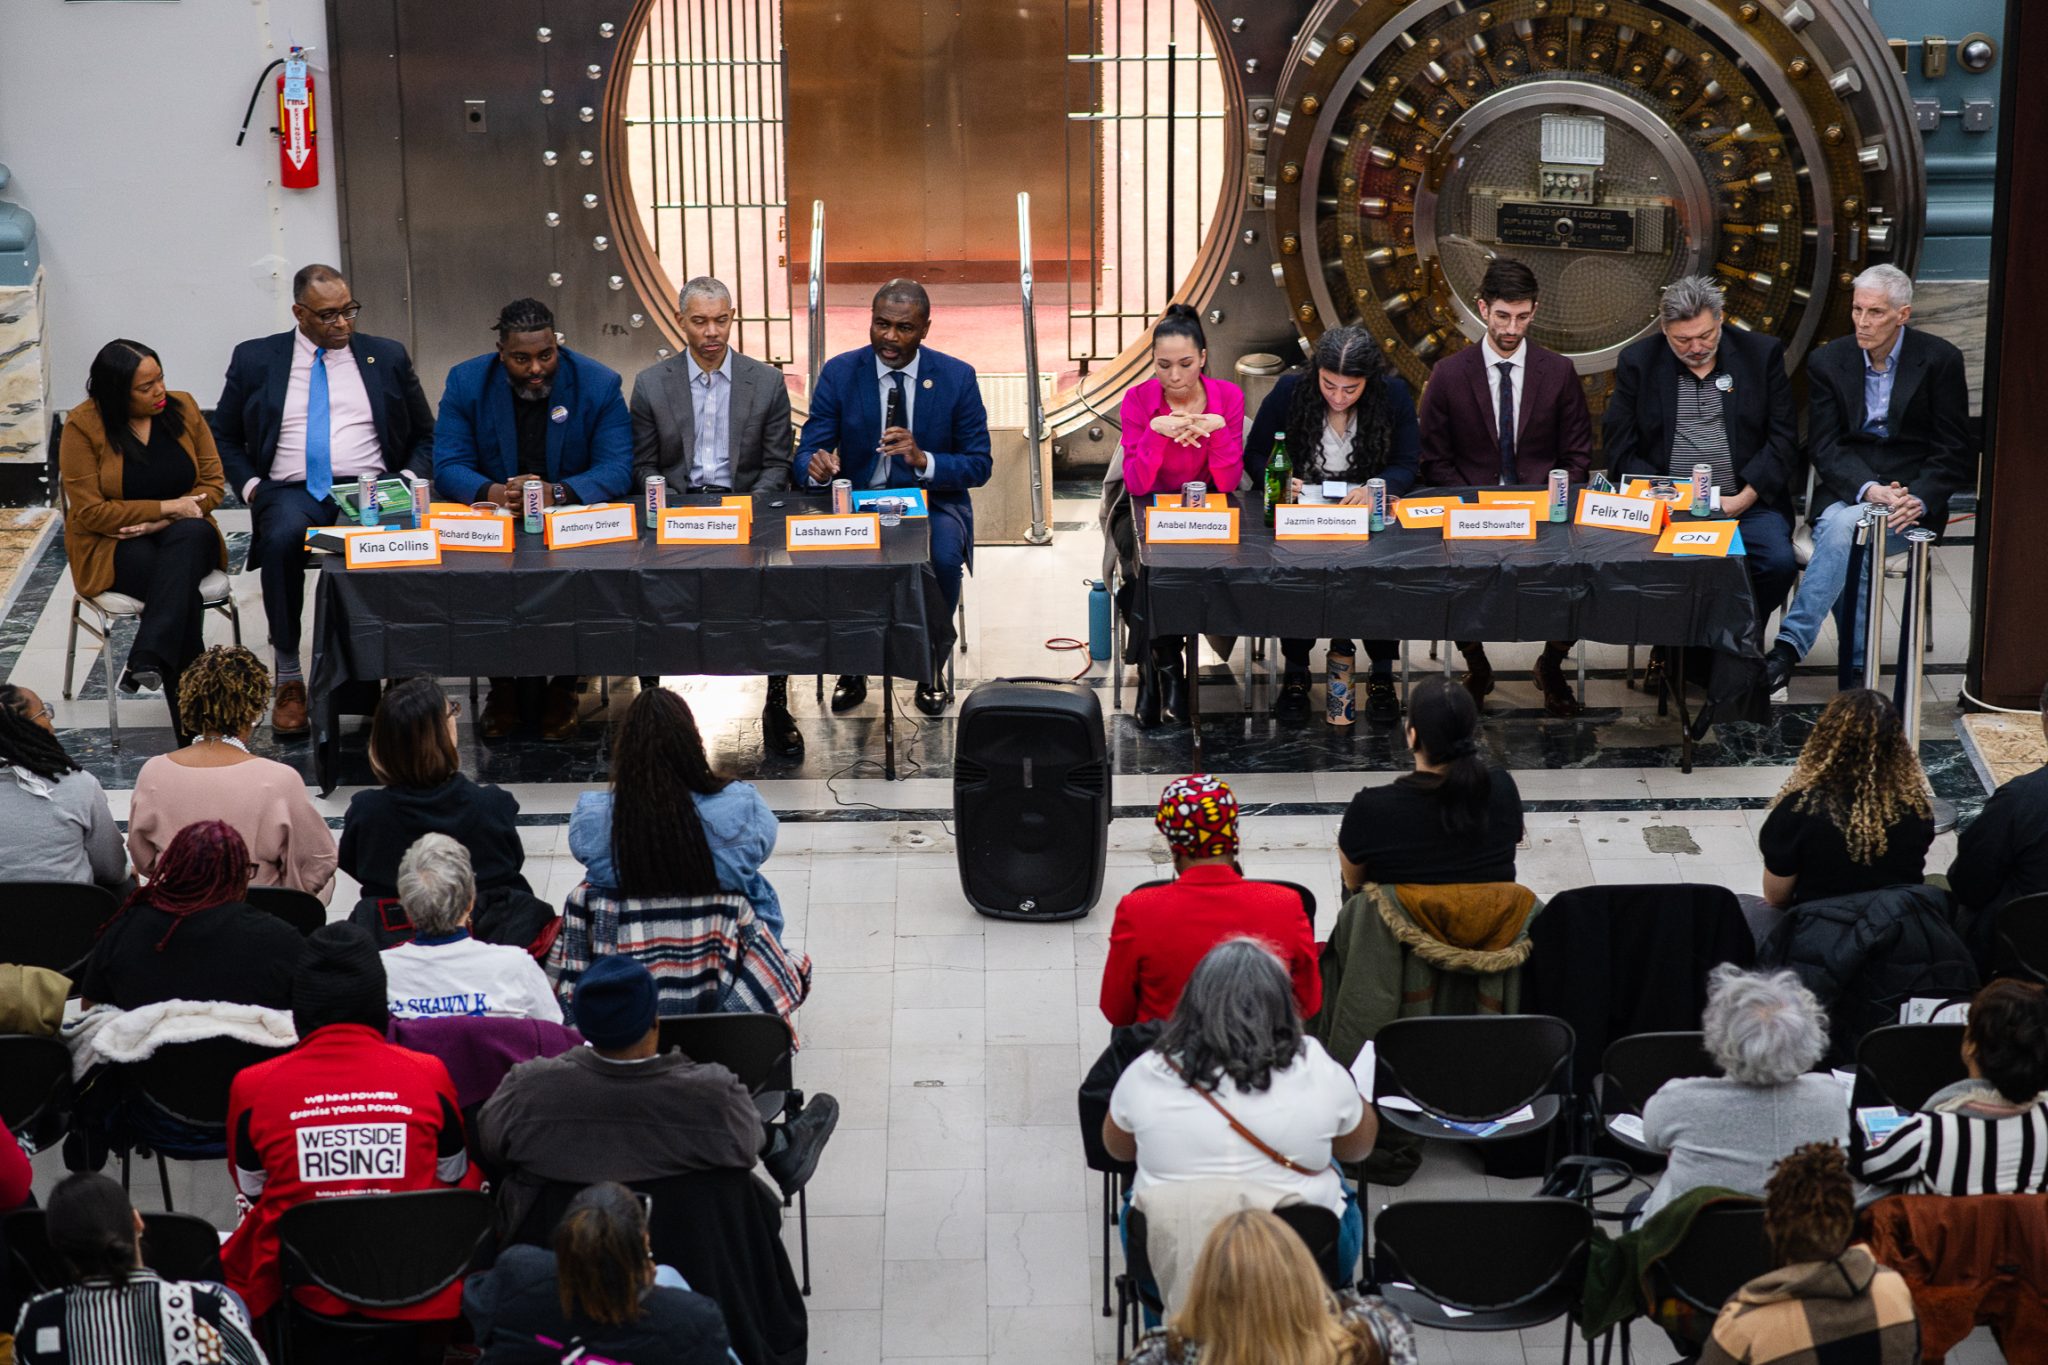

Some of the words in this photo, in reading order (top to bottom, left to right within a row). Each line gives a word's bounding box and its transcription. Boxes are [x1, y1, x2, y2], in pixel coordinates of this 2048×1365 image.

[1590, 504, 1619, 519] Felix
[1621, 508, 1650, 523] Tello
[560, 522, 594, 534] Anthony
[595, 519, 621, 530] Driver
[666, 520, 705, 530] Thomas
[707, 521, 737, 531] Fisher
[1157, 520, 1187, 530] Anabel
[1188, 521, 1228, 531] Mendoza
[1284, 517, 1315, 526] Jazmin
[1317, 517, 1357, 526] Robinson
[1459, 521, 1480, 530] Reed
[1482, 520, 1525, 530] Showalter
[438, 529, 470, 540] Richard
[471, 530, 500, 542] Boykin
[795, 526, 842, 537] Lashawn
[844, 526, 869, 537] Ford
[359, 540, 386, 553] Kina
[388, 540, 429, 553] Collins
[407, 993, 470, 1014] SHAWN
[301, 1127, 403, 1149] WESTSIDE
[304, 1147, 401, 1178] RISING!
